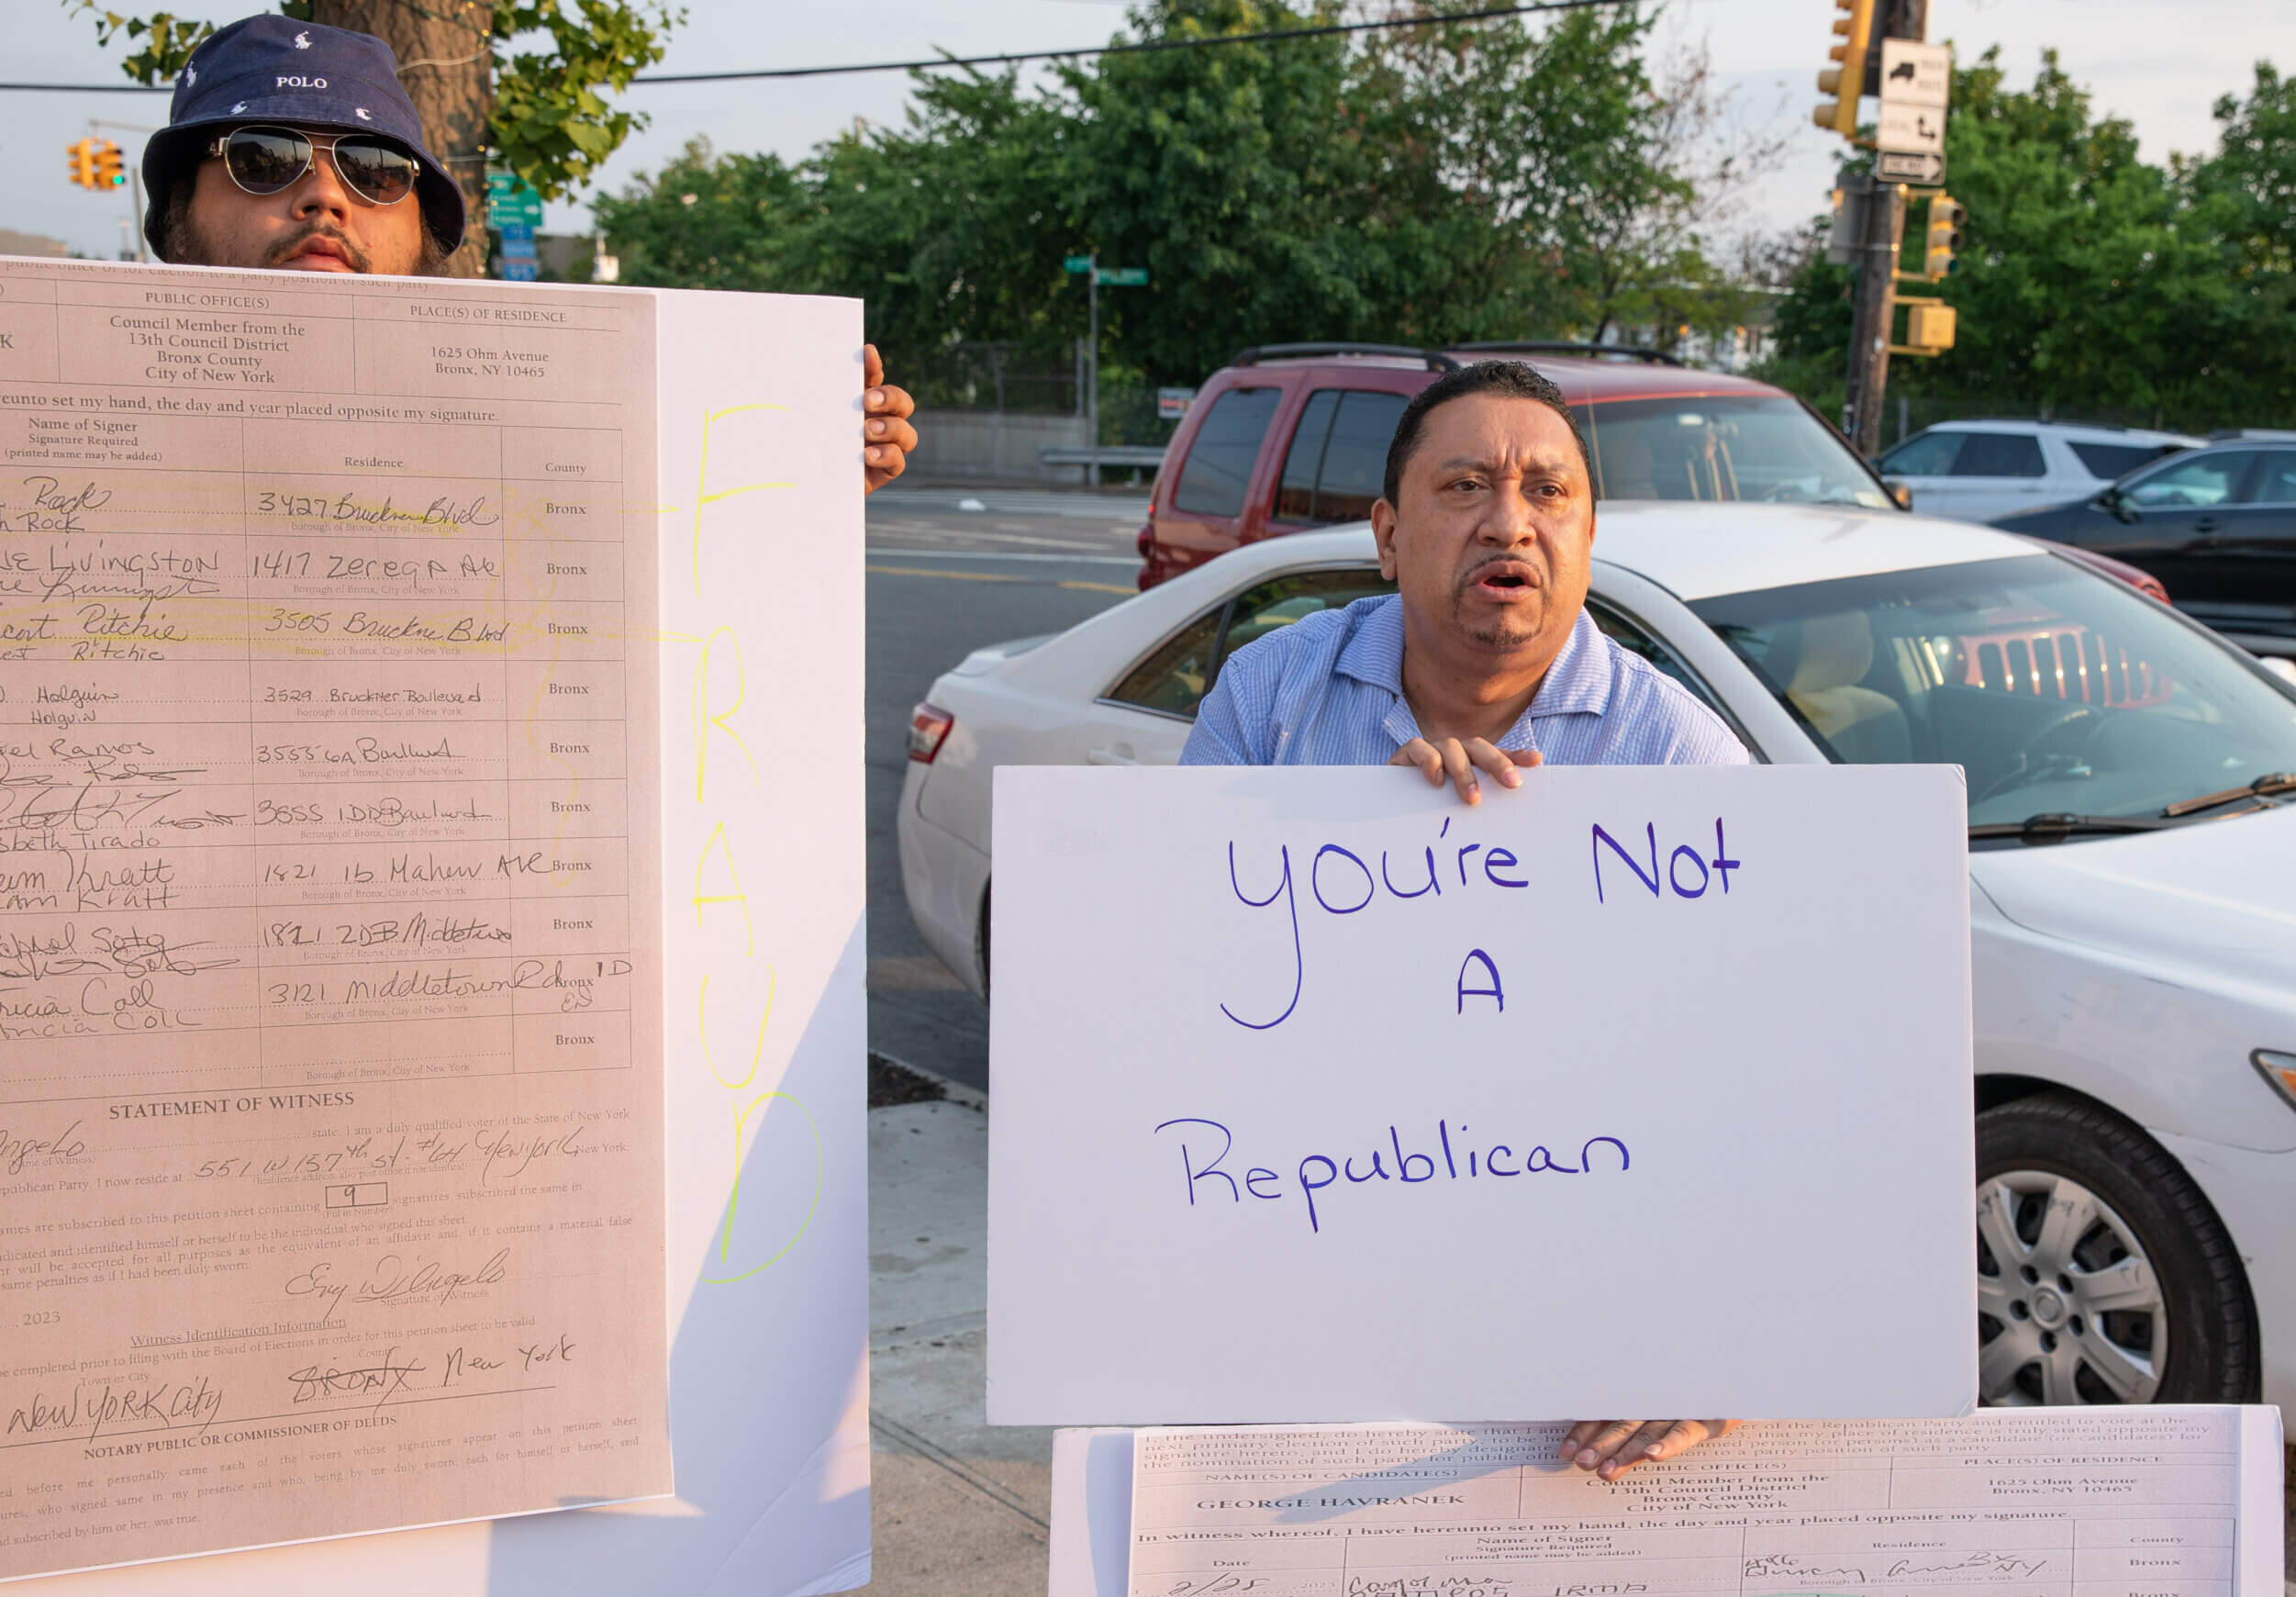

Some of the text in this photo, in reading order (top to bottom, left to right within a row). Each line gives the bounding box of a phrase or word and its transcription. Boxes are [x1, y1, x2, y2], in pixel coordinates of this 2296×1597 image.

[277, 75, 328, 89] POLO
[146, 292, 270, 309] PUBLIC OFFICE(S)
[410, 306, 567, 323] PLACE(S) OF RESIDENCE
[110, 315, 305, 336] Council Member from the
[129, 333, 289, 352] 13th Council District
[158, 352, 262, 369] Bronx County
[431, 346, 549, 362] 1625 Ohm Avenue
[146, 367, 275, 384] City of New York
[436, 363, 544, 378] Bronx, NY 10465
[52, 396, 499, 422] set my hand, the day and year placed opposite my signature.
[28, 419, 139, 433] Name of Signer
[29, 434, 139, 447] Signature Required
[5, 449, 162, 462] (printed name may be added)
[344, 457, 404, 469] Residence
[545, 463, 586, 474] County
[258, 493, 327, 514] 3427
[546, 503, 587, 516] Bronx
[252, 551, 310, 577] 1417
[547, 564, 587, 575] Bronx
[548, 623, 588, 635] Bronx
[264, 687, 312, 702] 3529
[550, 683, 589, 695] Bronx
[551, 743, 590, 754] Bronx
[551, 801, 591, 813] Bronx
[71, 832, 161, 849] Tirado
[552, 860, 592, 872] Bronx
[1590, 815, 1741, 905] Not
[553, 919, 594, 931] Bronx
[1455, 948, 1505, 1014] A
[268, 984, 325, 1004] 3121
[555, 1033, 595, 1045] Bronx
[109, 1091, 354, 1120] STATEMENT OF WITNESS
[1153, 1118, 1632, 1234] Republican
[343, 1186, 356, 1206] 9
[23, 1311, 61, 1326] 2023
[131, 1315, 346, 1346] Witness Identification Information
[84, 1415, 397, 1460] NOTARY PUBLIC OR COMMISSIONER OF DEEDS
[1700, 1462, 1787, 1470] OFFICE(S)
[1205, 1473, 1286, 1482] NAME(S)
[1323, 1469, 1458, 1480] CANDIDATE(S)
[1668, 1476, 1744, 1485] Member
[1658, 1485, 1732, 1493] Council
[1740, 1483, 1808, 1491] District
[1992, 1488, 2045, 1496] Bronx,
[2083, 1486, 2133, 1494] 10465
[1197, 1494, 1466, 1510] GEORGE HAVRANEK
[1643, 1493, 1774, 1502] Bronx County
[1626, 1500, 1788, 1513] City of New York
[1139, 1535, 1160, 1543] In
[1166, 1530, 1243, 1541] witness
[1251, 1527, 1339, 1538] whereof,
[1360, 1526, 1406, 1536] have
[1413, 1521, 1500, 1536] hereunto
[1509, 1522, 1538, 1532] set
[1543, 1523, 1573, 1534] my
[1579, 1520, 1632, 1530] hand,
[1639, 1519, 1668, 1528] the
[1674, 1518, 1706, 1530] day
[1714, 1517, 1748, 1526] and
[1755, 1517, 1795, 1528] year
[1800, 1513, 1859, 1524] placed
[1865, 1511, 1945, 1524] opposite
[1949, 1513, 1978, 1523] my
[1984, 1511, 2071, 1522] signature.
[1872, 1540, 1945, 1549] Residence
